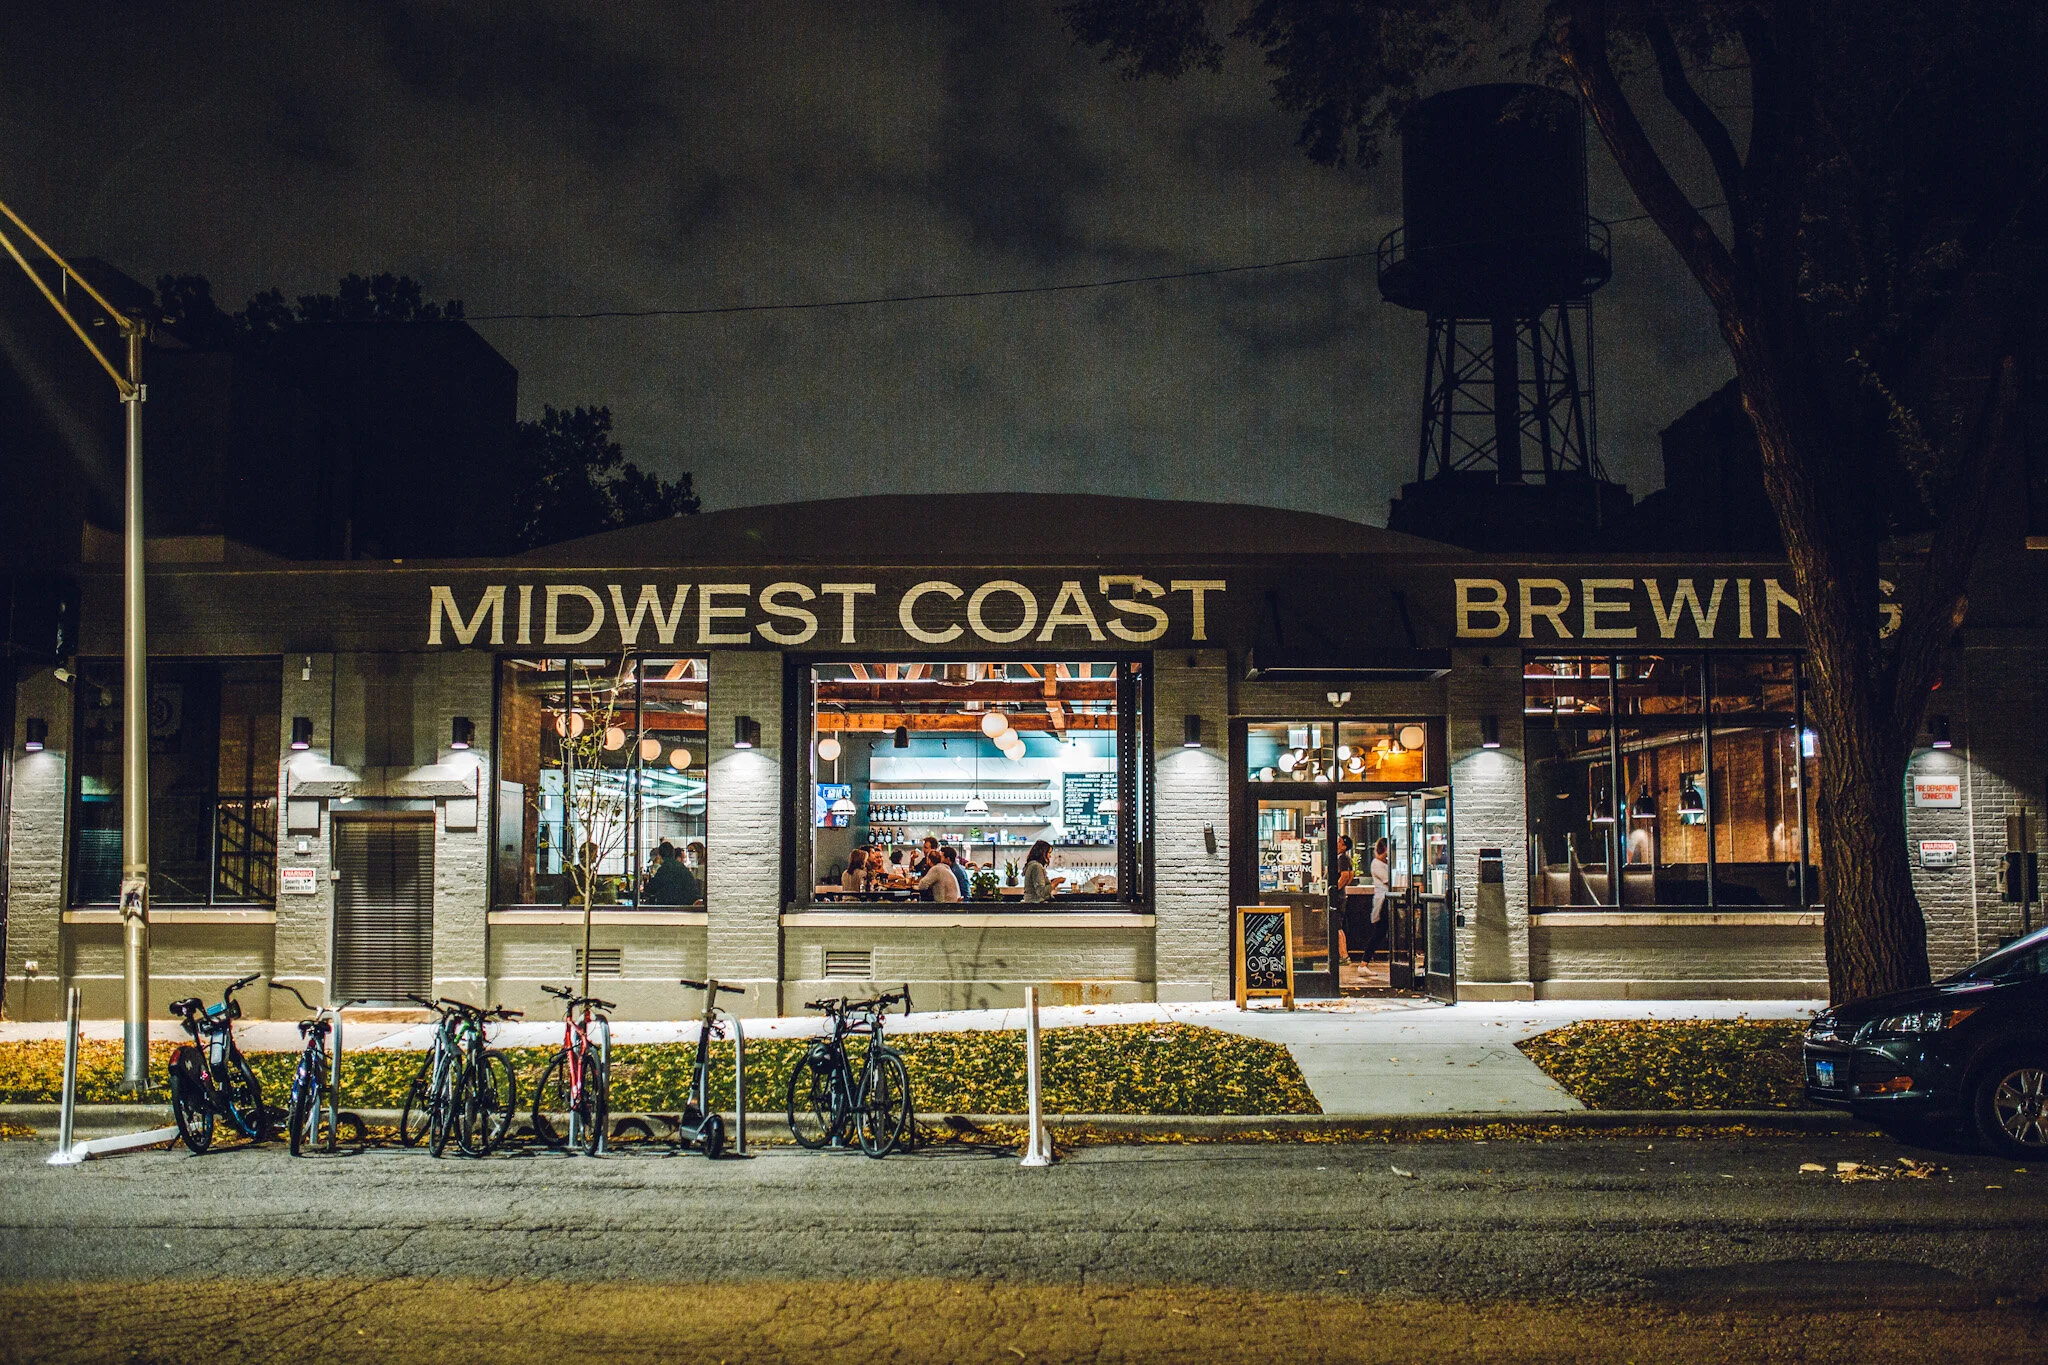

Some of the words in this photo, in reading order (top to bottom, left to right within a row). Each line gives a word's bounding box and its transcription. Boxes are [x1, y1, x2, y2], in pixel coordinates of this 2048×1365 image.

[428, 583, 875, 646] MIDWEST
[898, 578, 1226, 645] COAST
[1915, 784, 1926, 792] FIRE
[1926, 784, 1959, 792] DEPARTMENT
[1922, 792, 1953, 800] CONNECTION
[1268, 843, 1316, 851] MIEST
[1265, 852, 1312, 863] COAS
[1247, 955, 1286, 972] OPEN
